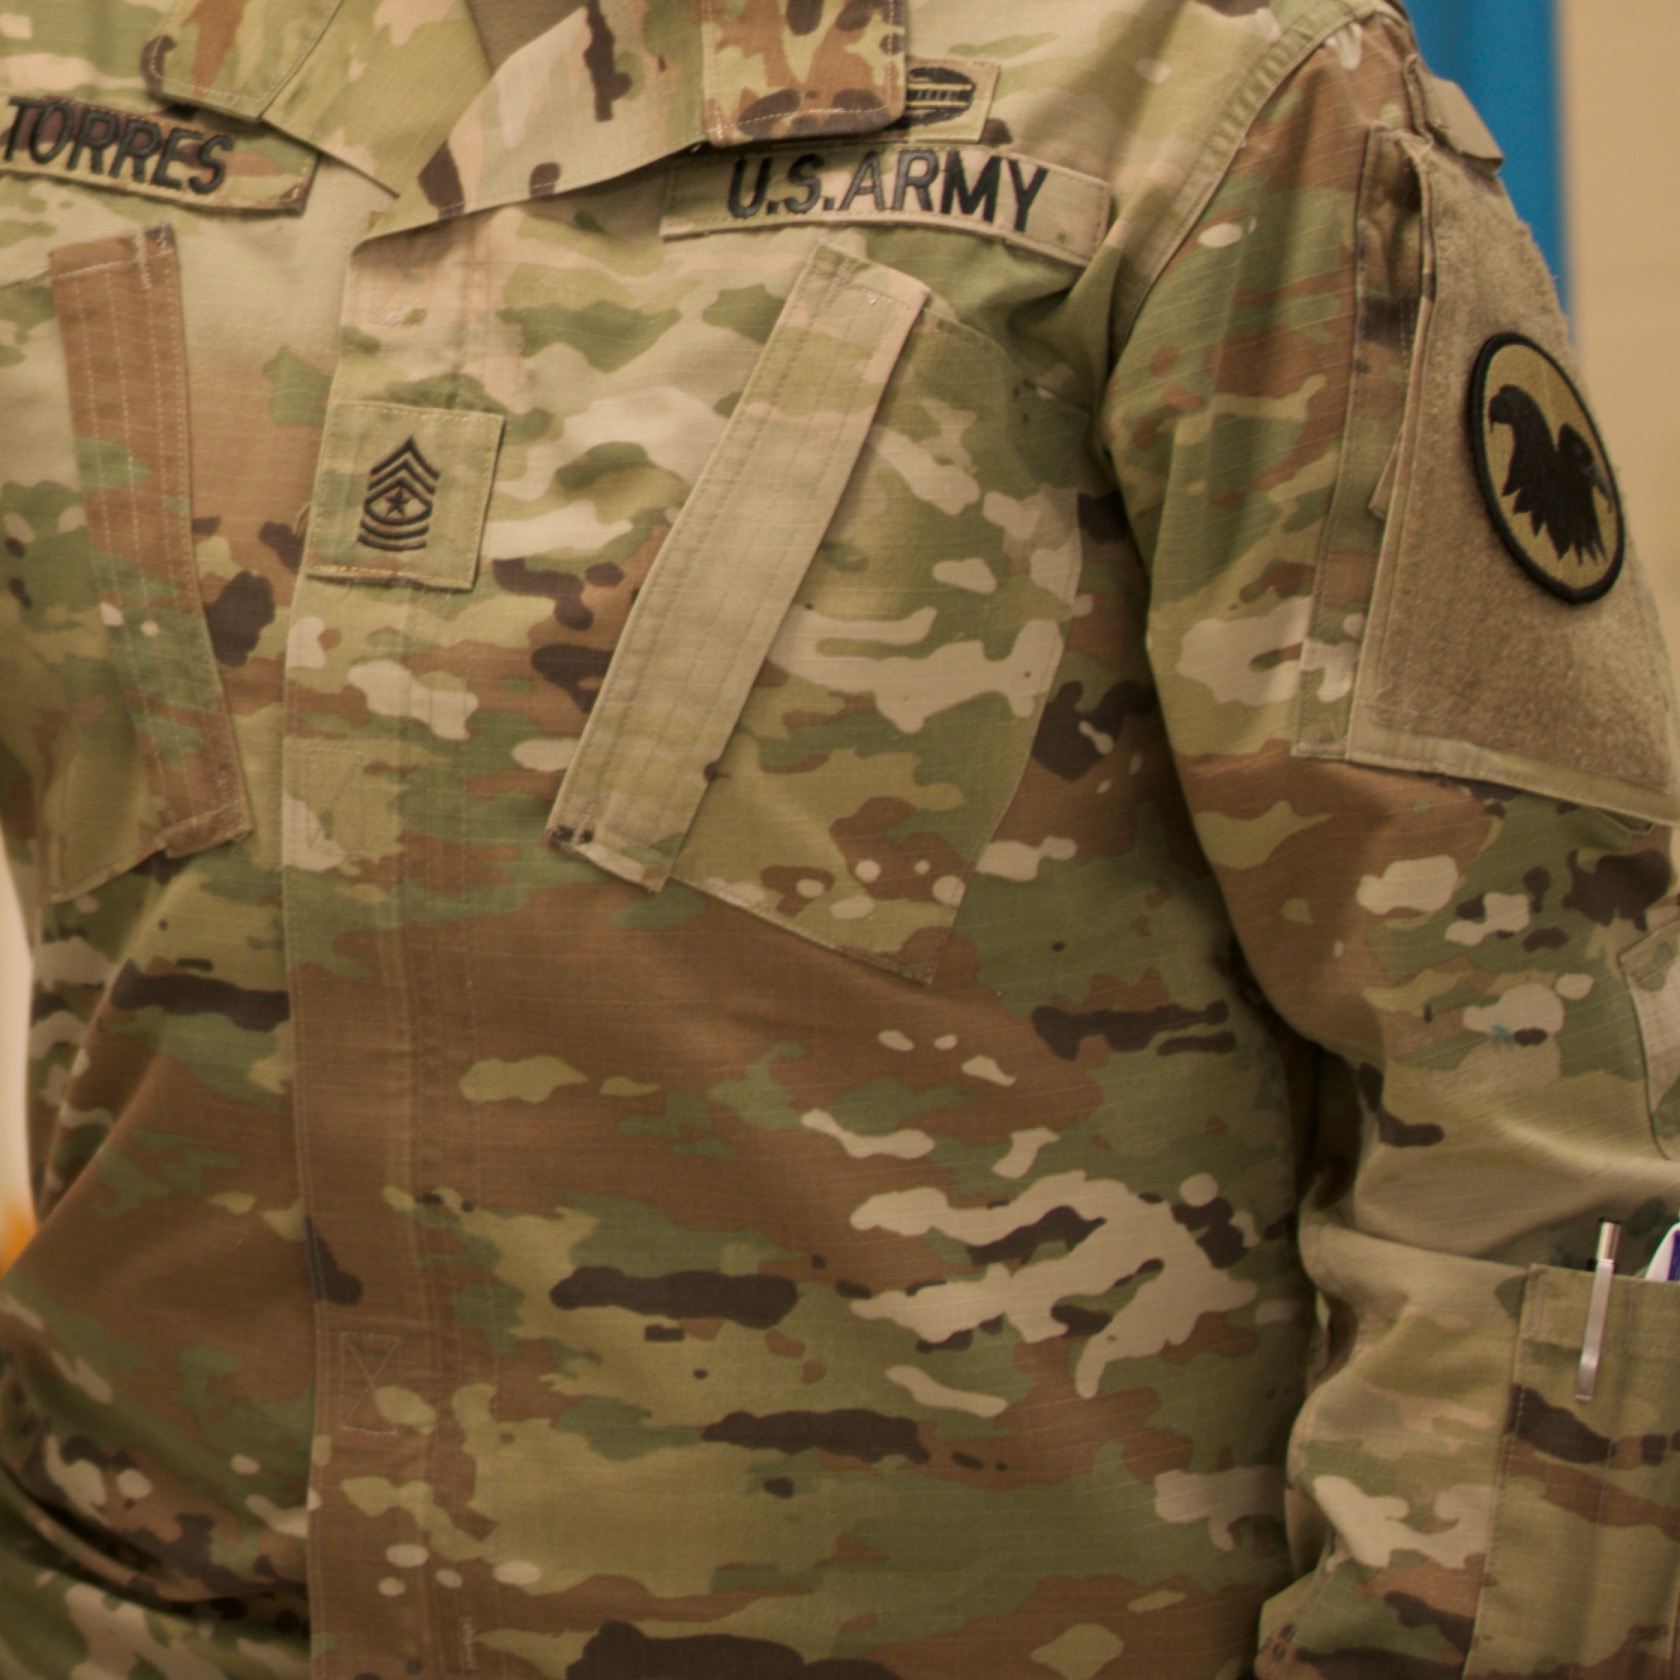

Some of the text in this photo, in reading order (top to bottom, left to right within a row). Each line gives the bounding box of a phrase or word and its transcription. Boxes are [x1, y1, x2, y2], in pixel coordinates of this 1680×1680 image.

[2, 95, 234, 195] TORRES
[727, 148, 1051, 231] U.S. ARMY
